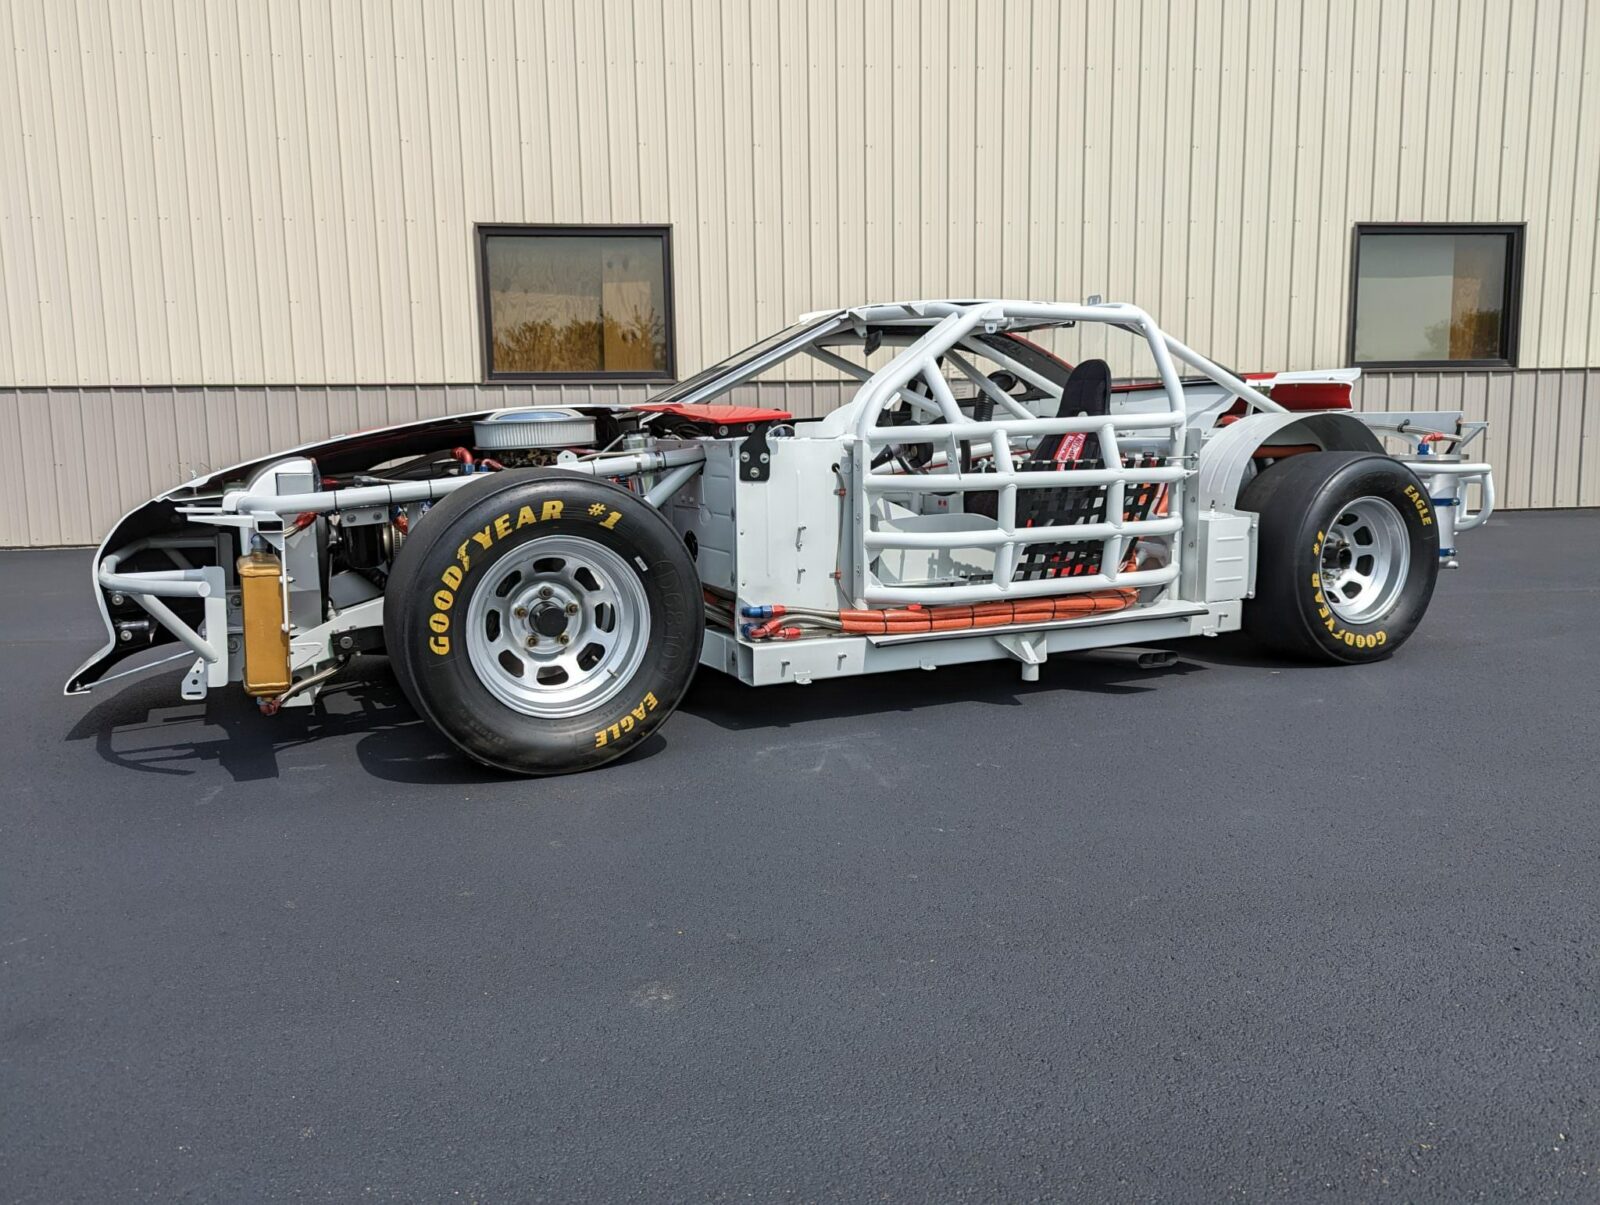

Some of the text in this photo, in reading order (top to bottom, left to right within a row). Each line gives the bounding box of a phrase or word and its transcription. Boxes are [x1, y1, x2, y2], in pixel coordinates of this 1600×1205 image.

[1403, 485, 1432, 526] EAGLE
[429, 500, 623, 656] GOODYEAR #1
[1311, 573, 1387, 648] GOODYEAR
[594, 691, 660, 748] EAGLE
